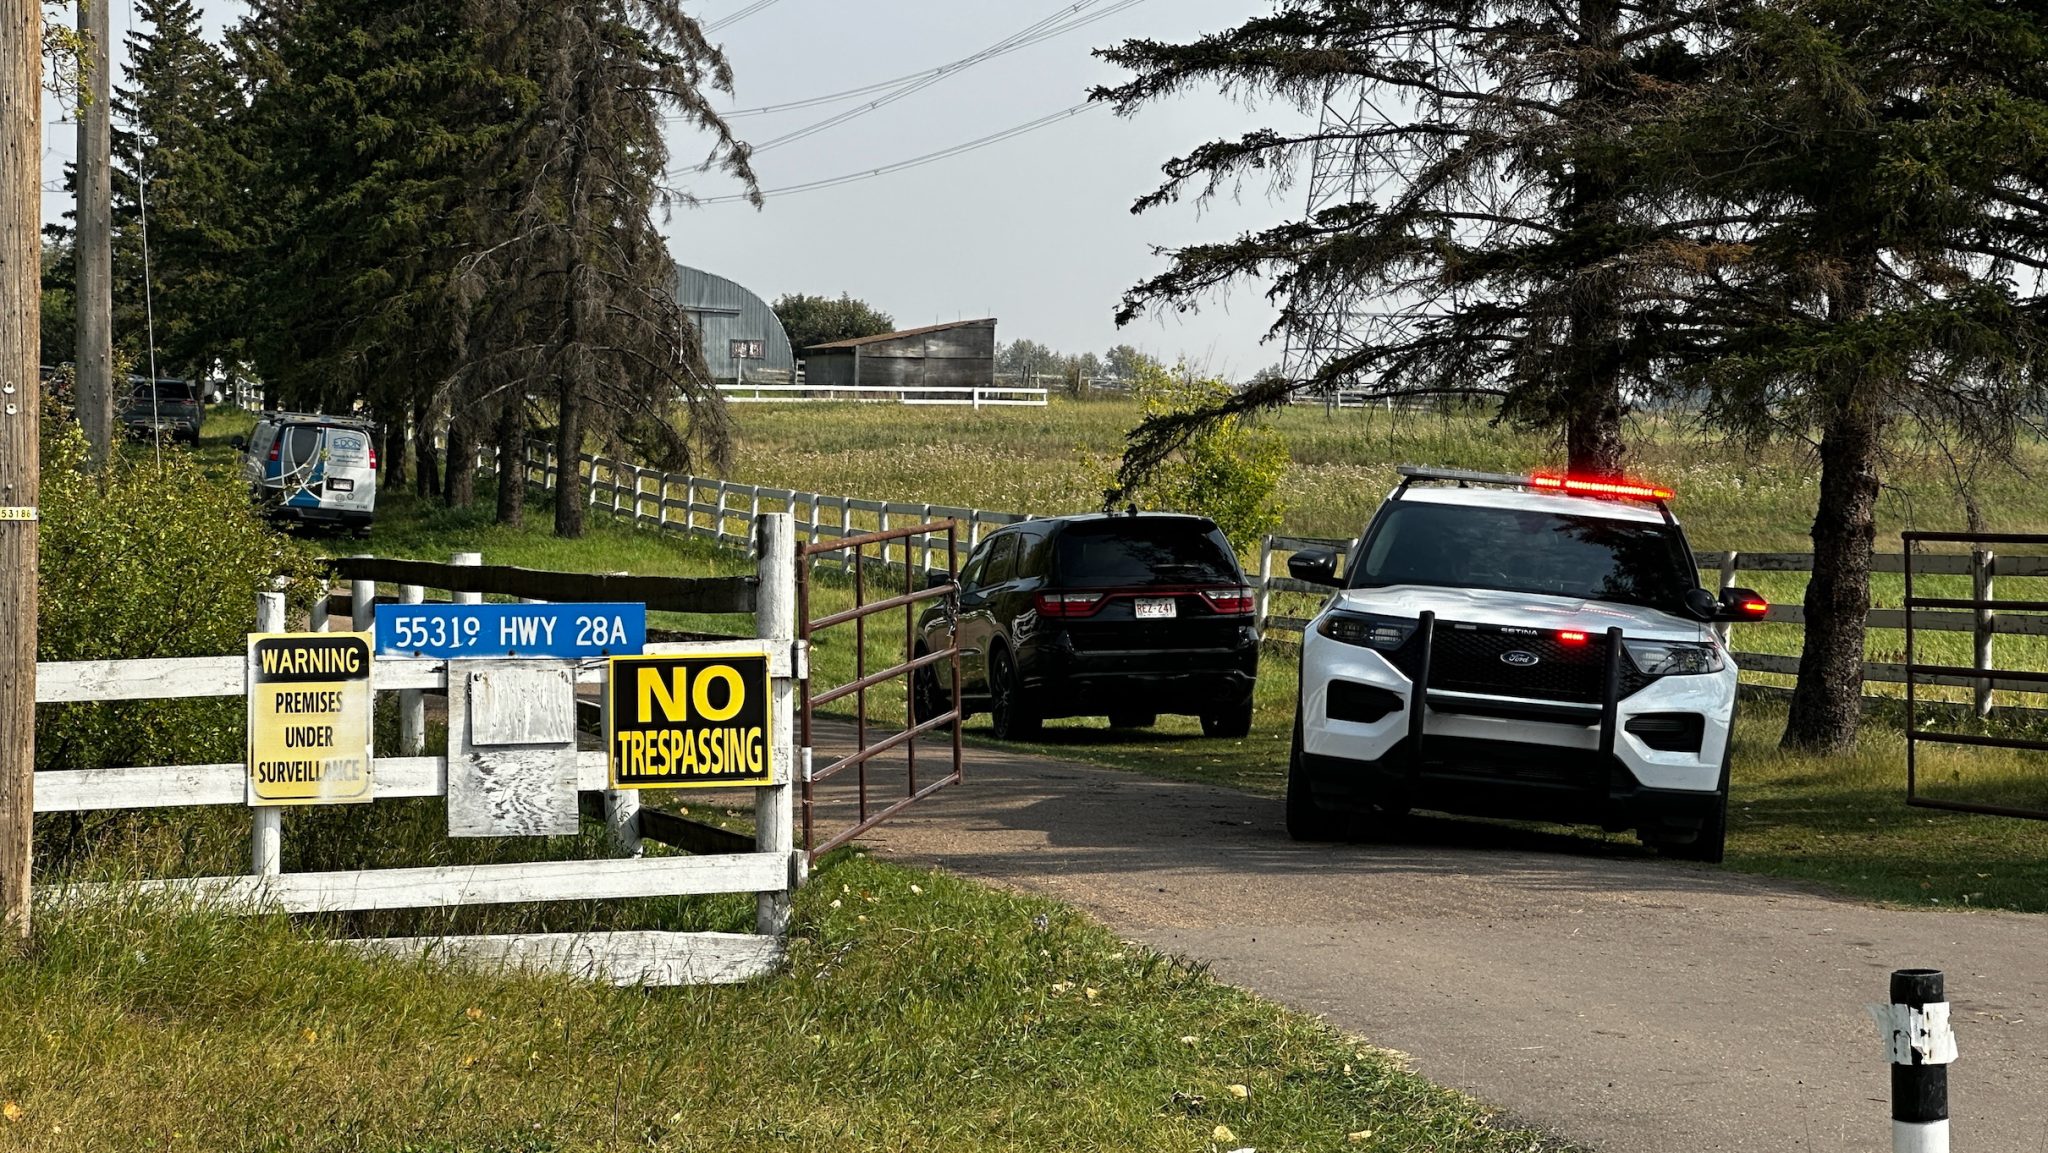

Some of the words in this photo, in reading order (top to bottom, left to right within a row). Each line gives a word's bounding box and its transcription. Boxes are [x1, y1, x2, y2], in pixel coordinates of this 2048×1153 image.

[1, 509, 31, 518] 53186
[395, 616, 480, 648] 55319
[500, 616, 557, 646] HWY
[575, 615, 627, 646] 28A
[1500, 627, 1538, 636] SETINA
[261, 647, 360, 674] WARNING
[275, 691, 343, 713] PREMISES
[637, 664, 745, 723] NO
[285, 725, 334, 748] UNDER
[618, 726, 763, 776] TRESPASSING
[258, 759, 360, 783] SURVEILLANCE
